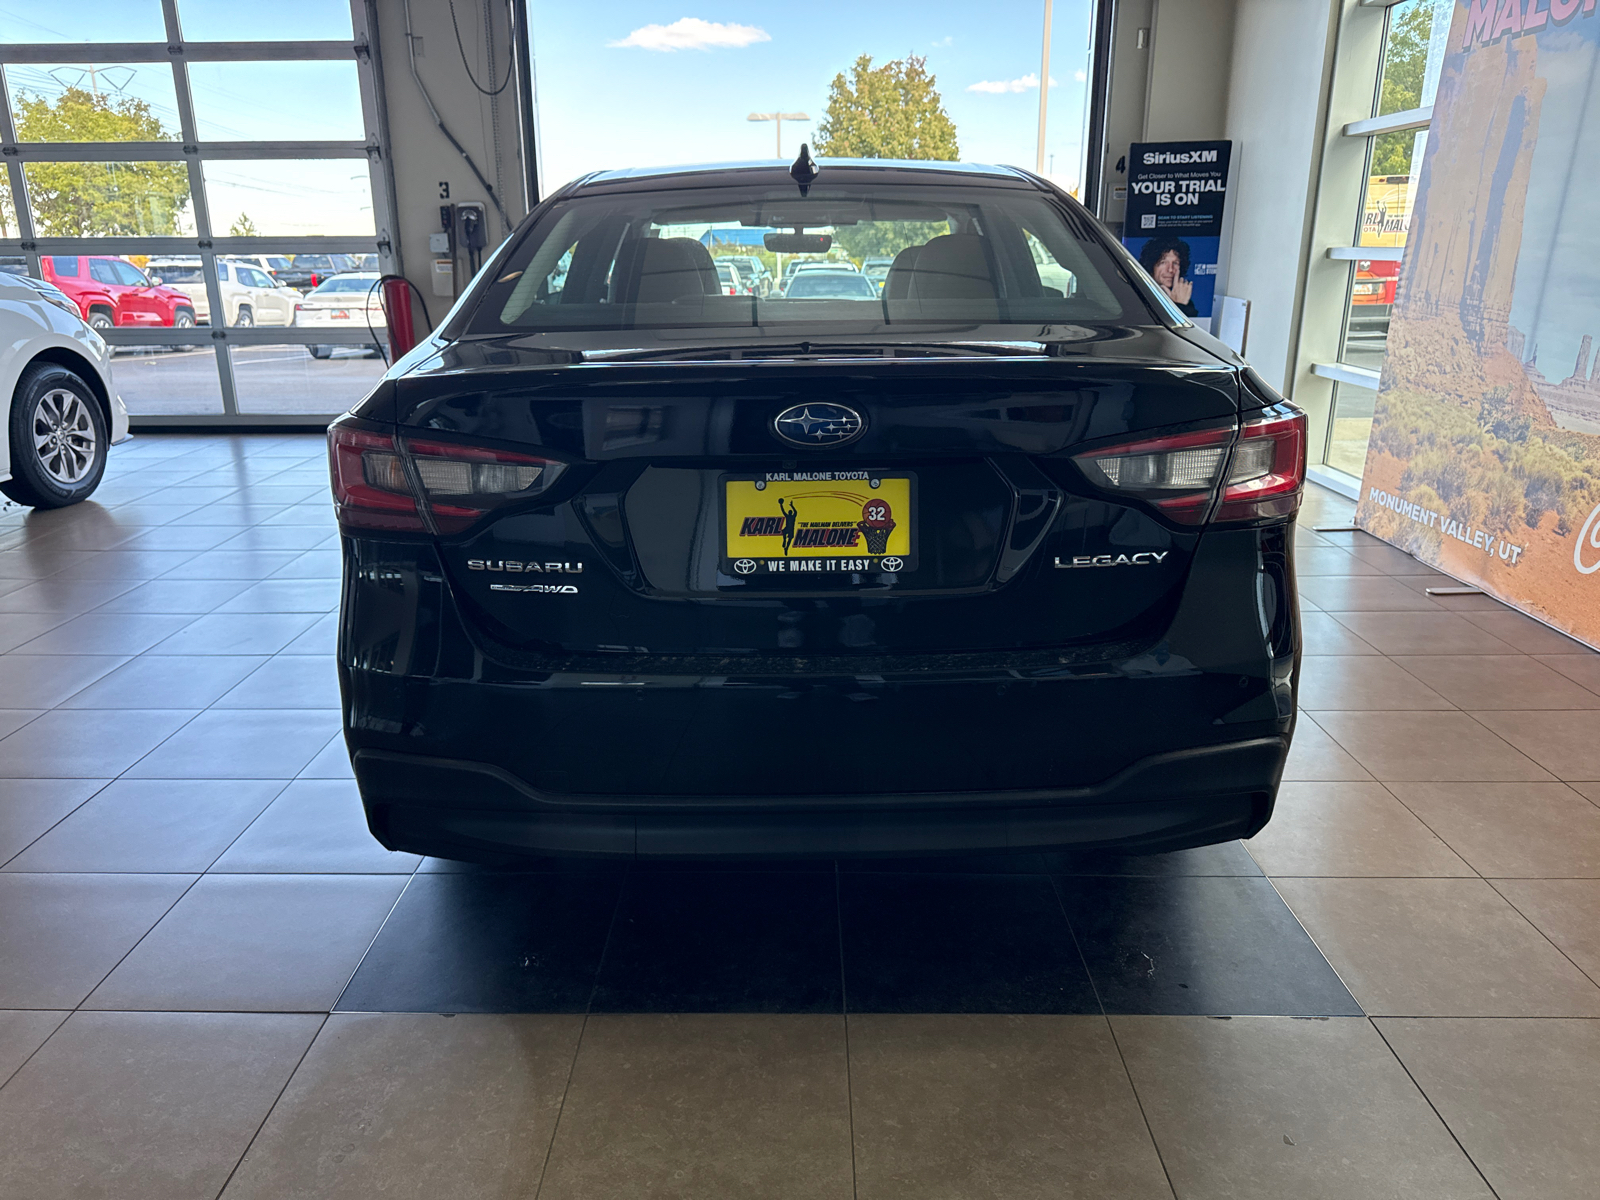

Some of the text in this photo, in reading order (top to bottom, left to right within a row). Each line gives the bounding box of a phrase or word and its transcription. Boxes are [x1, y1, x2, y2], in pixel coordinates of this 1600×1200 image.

[1462, 0, 1597, 54] MAL
[1115, 155, 1126, 174] 4
[1143, 150, 1218, 165] SiriusXM
[439, 181, 450, 199] 3
[1131, 181, 1175, 194] YOUR
[1179, 179, 1226, 192] TRIAL
[1155, 193, 1199, 206] IS ON
[766, 471, 869, 481] KARL MALONE TOYOTA
[868, 506, 886, 521] 32
[739, 516, 785, 537] KARL
[1369, 487, 1522, 564] MONUMENT VALLEY, UT
[792, 528, 860, 548] MALONE
[467, 559, 583, 573] SUBARU
[768, 559, 870, 571] WE MAKE IT EASY
[1054, 551, 1168, 568] LEGACY
[523, 584, 578, 593] AWD
